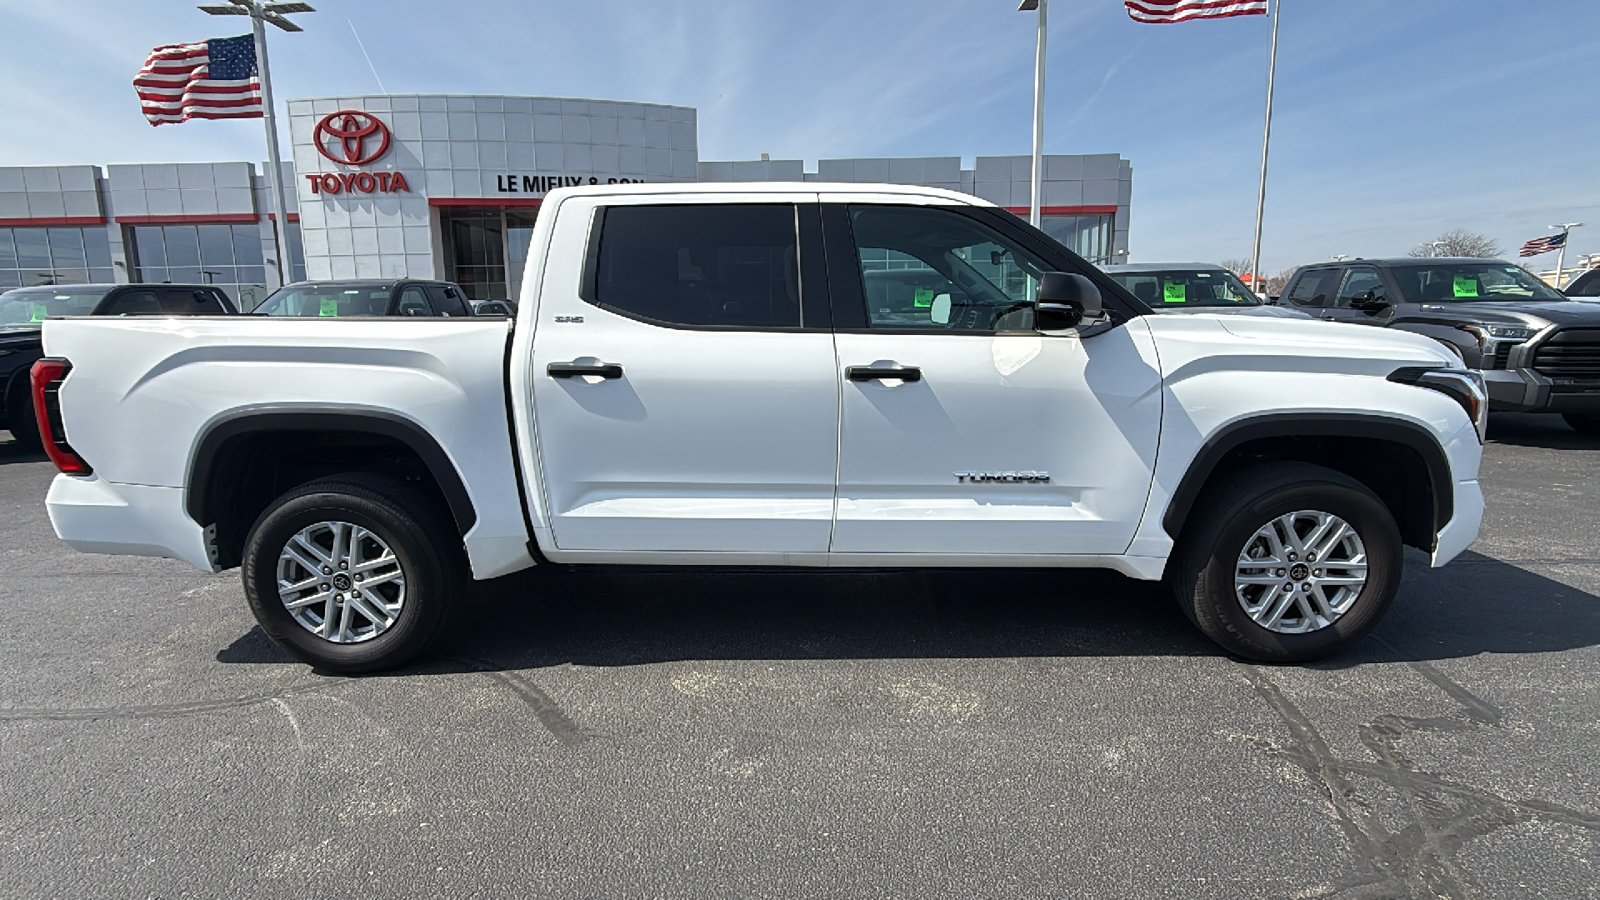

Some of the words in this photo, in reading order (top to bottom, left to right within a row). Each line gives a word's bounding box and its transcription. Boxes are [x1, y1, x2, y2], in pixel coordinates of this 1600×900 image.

[305, 171, 410, 194] TOYOTA
[497, 174, 518, 193] LE
[952, 470, 1050, 484] TUNDRA
